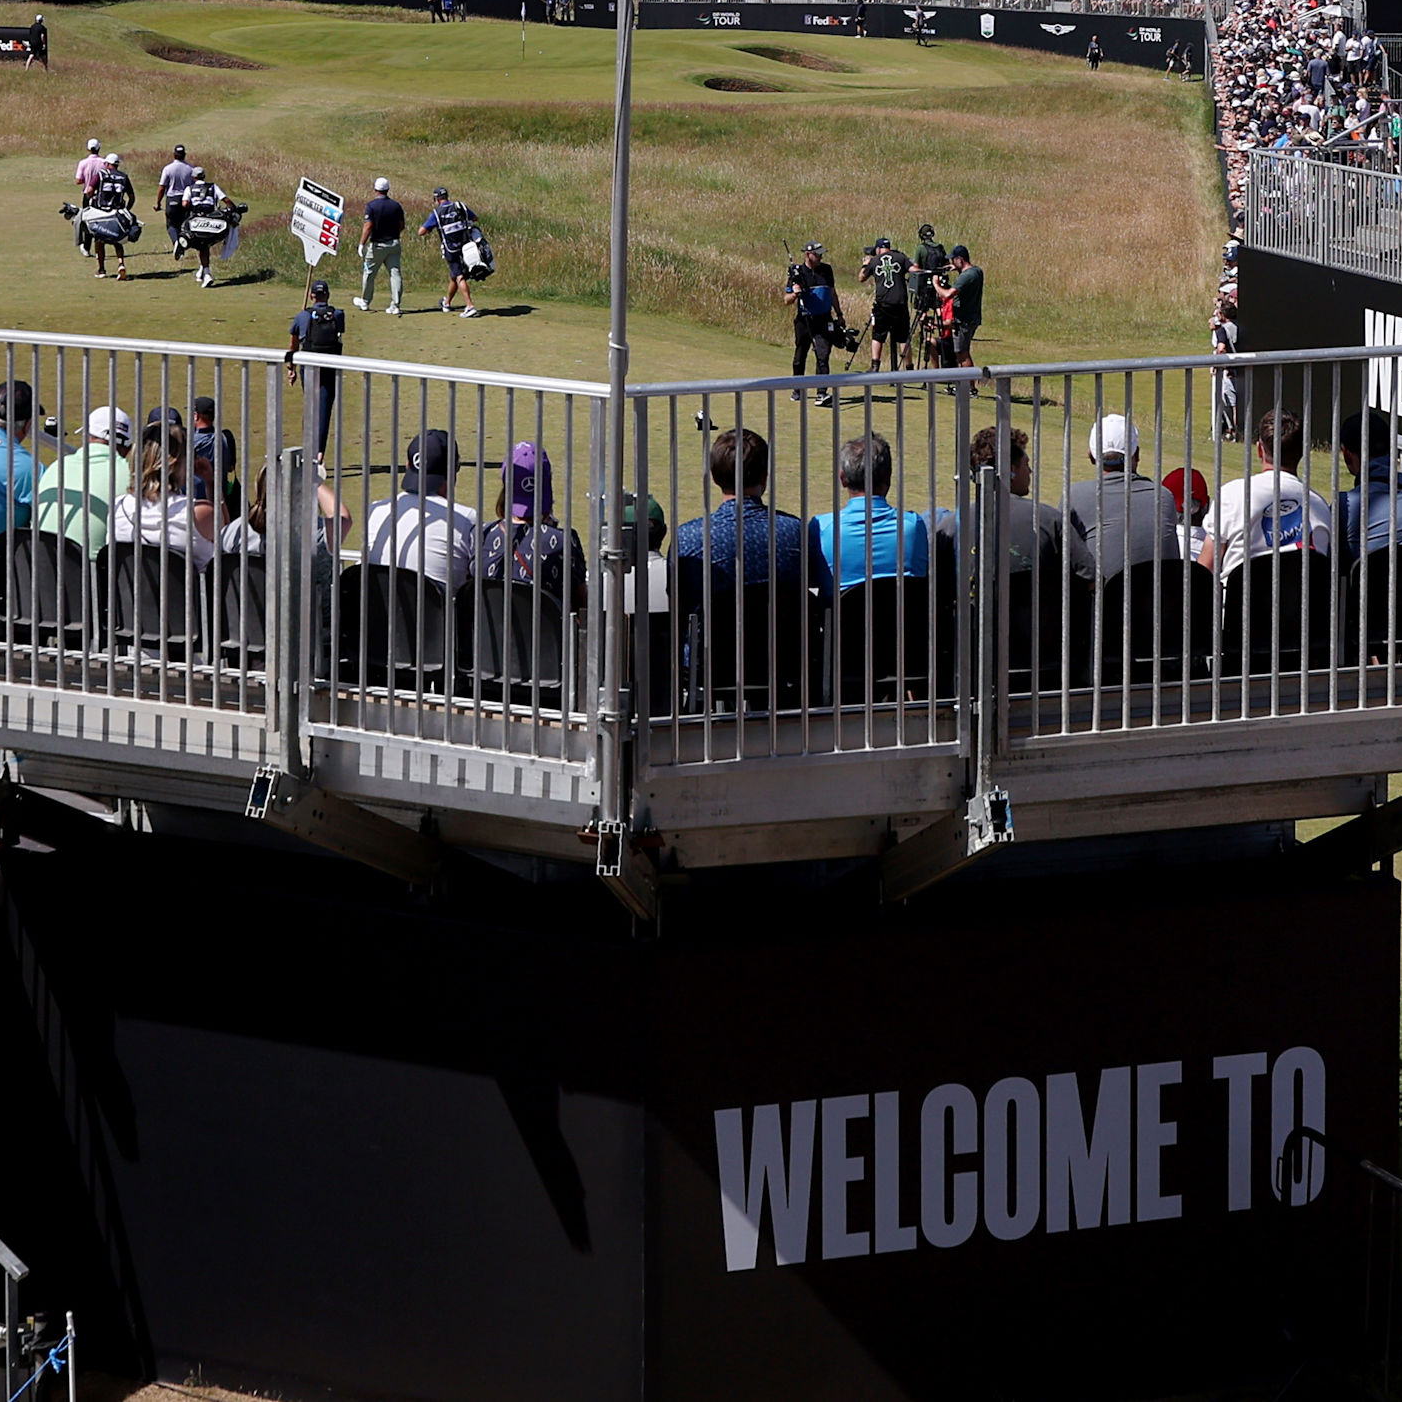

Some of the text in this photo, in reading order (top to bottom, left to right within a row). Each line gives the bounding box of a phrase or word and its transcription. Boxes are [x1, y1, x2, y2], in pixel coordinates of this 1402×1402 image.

[713, 16, 741, 26] TOUR
[812, 16, 840, 26] FedEx
[1140, 32, 1162, 42] TOUR
[323, 223, 338, 235] -4
[321, 236, 336, 248] -2
[714, 1046, 1326, 1273] WELCOME TO
